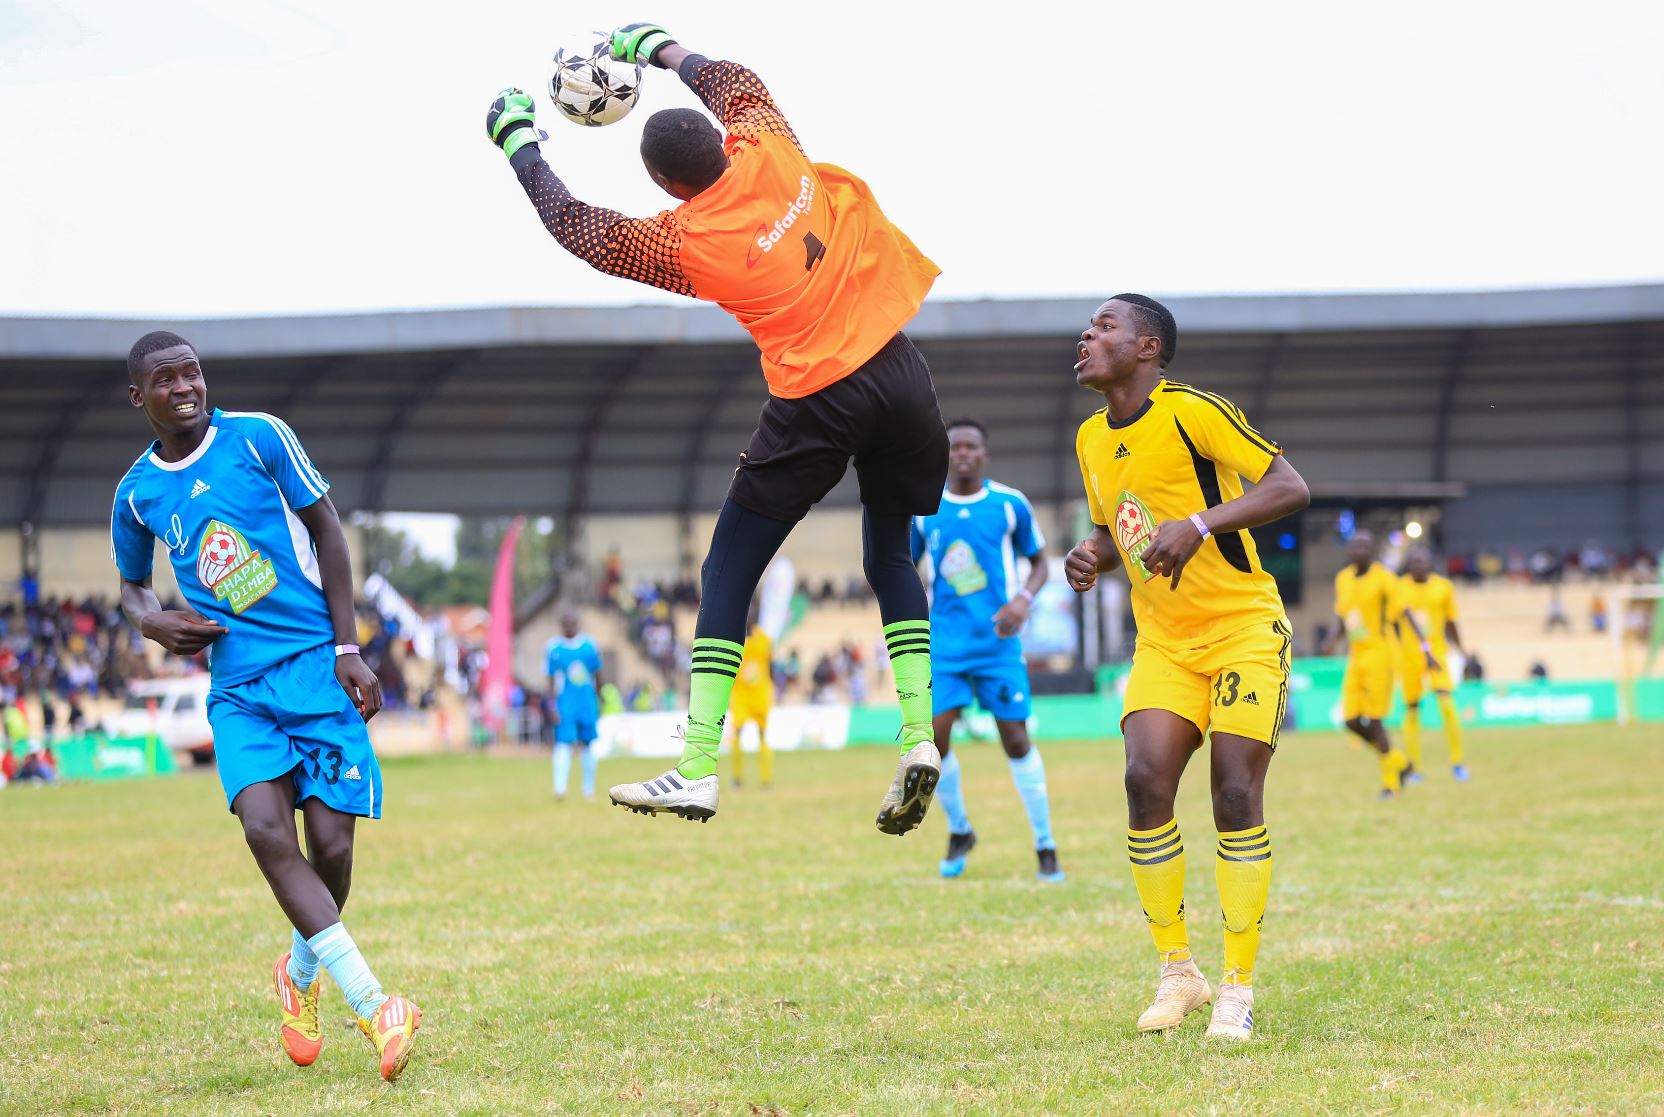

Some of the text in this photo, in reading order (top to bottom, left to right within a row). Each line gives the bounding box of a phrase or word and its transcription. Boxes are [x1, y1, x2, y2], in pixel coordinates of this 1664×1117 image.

[757, 175, 811, 253] Safaricom
[1114, 451, 1131, 460] adidas
[190, 484, 211, 499] adidas
[215, 559, 262, 597] CHAPA
[231, 566, 273, 602] DIMBA
[1214, 671, 1241, 707] 13
[308, 747, 343, 785] 13
